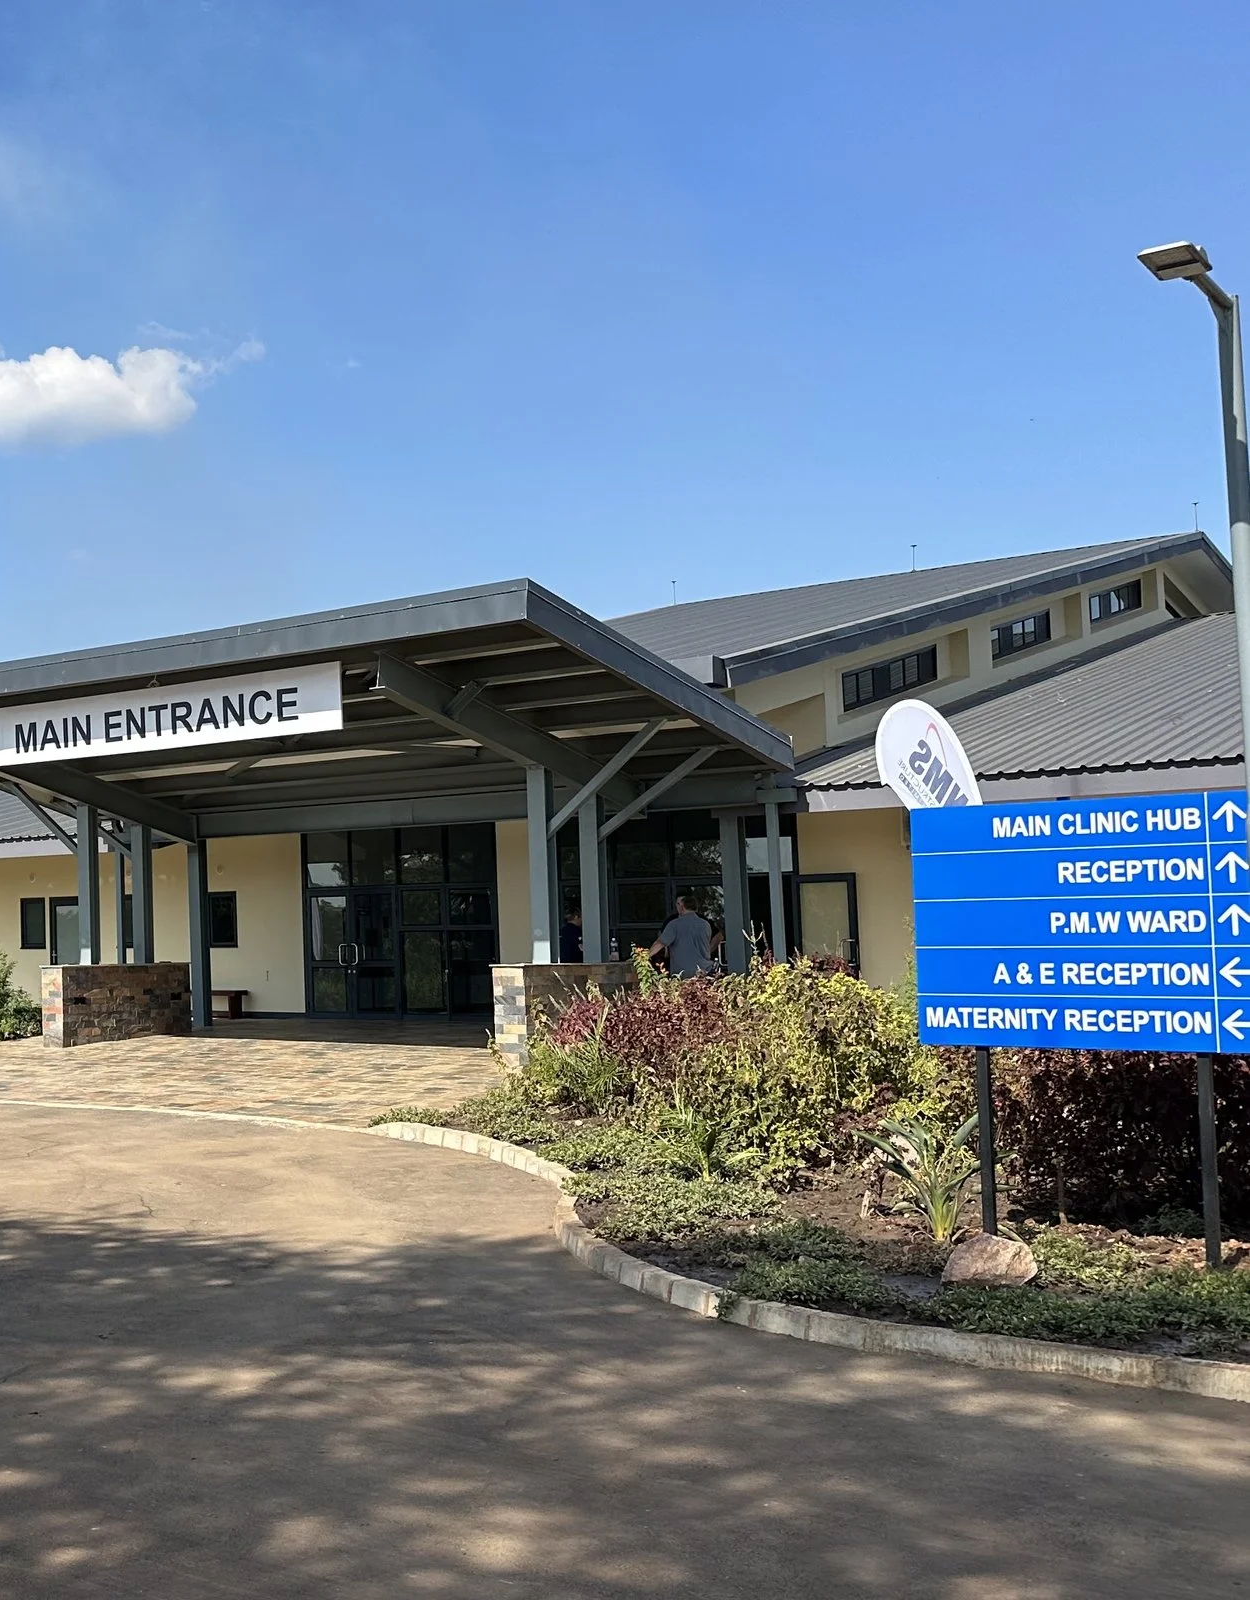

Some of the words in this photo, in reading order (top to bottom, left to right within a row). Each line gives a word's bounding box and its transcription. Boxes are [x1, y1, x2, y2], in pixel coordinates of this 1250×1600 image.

[15, 715, 92, 754] MAIN
[104, 687, 299, 743] ENTRANCE
[993, 816, 1051, 838] MAIN
[1058, 811, 1139, 836] CLINIC
[1146, 807, 1201, 832] HUB
[1057, 857, 1205, 884] RECEPTION
[1050, 911, 1120, 934] P.M.W
[1127, 910, 1207, 933] WARD
[993, 963, 1012, 985] A
[1016, 963, 1034, 985] &
[1039, 963, 1056, 985] E
[1062, 963, 1210, 986] RECEPTION
[925, 1007, 1058, 1029] MATERNITY
[1064, 1009, 1213, 1035] RECEPTION
